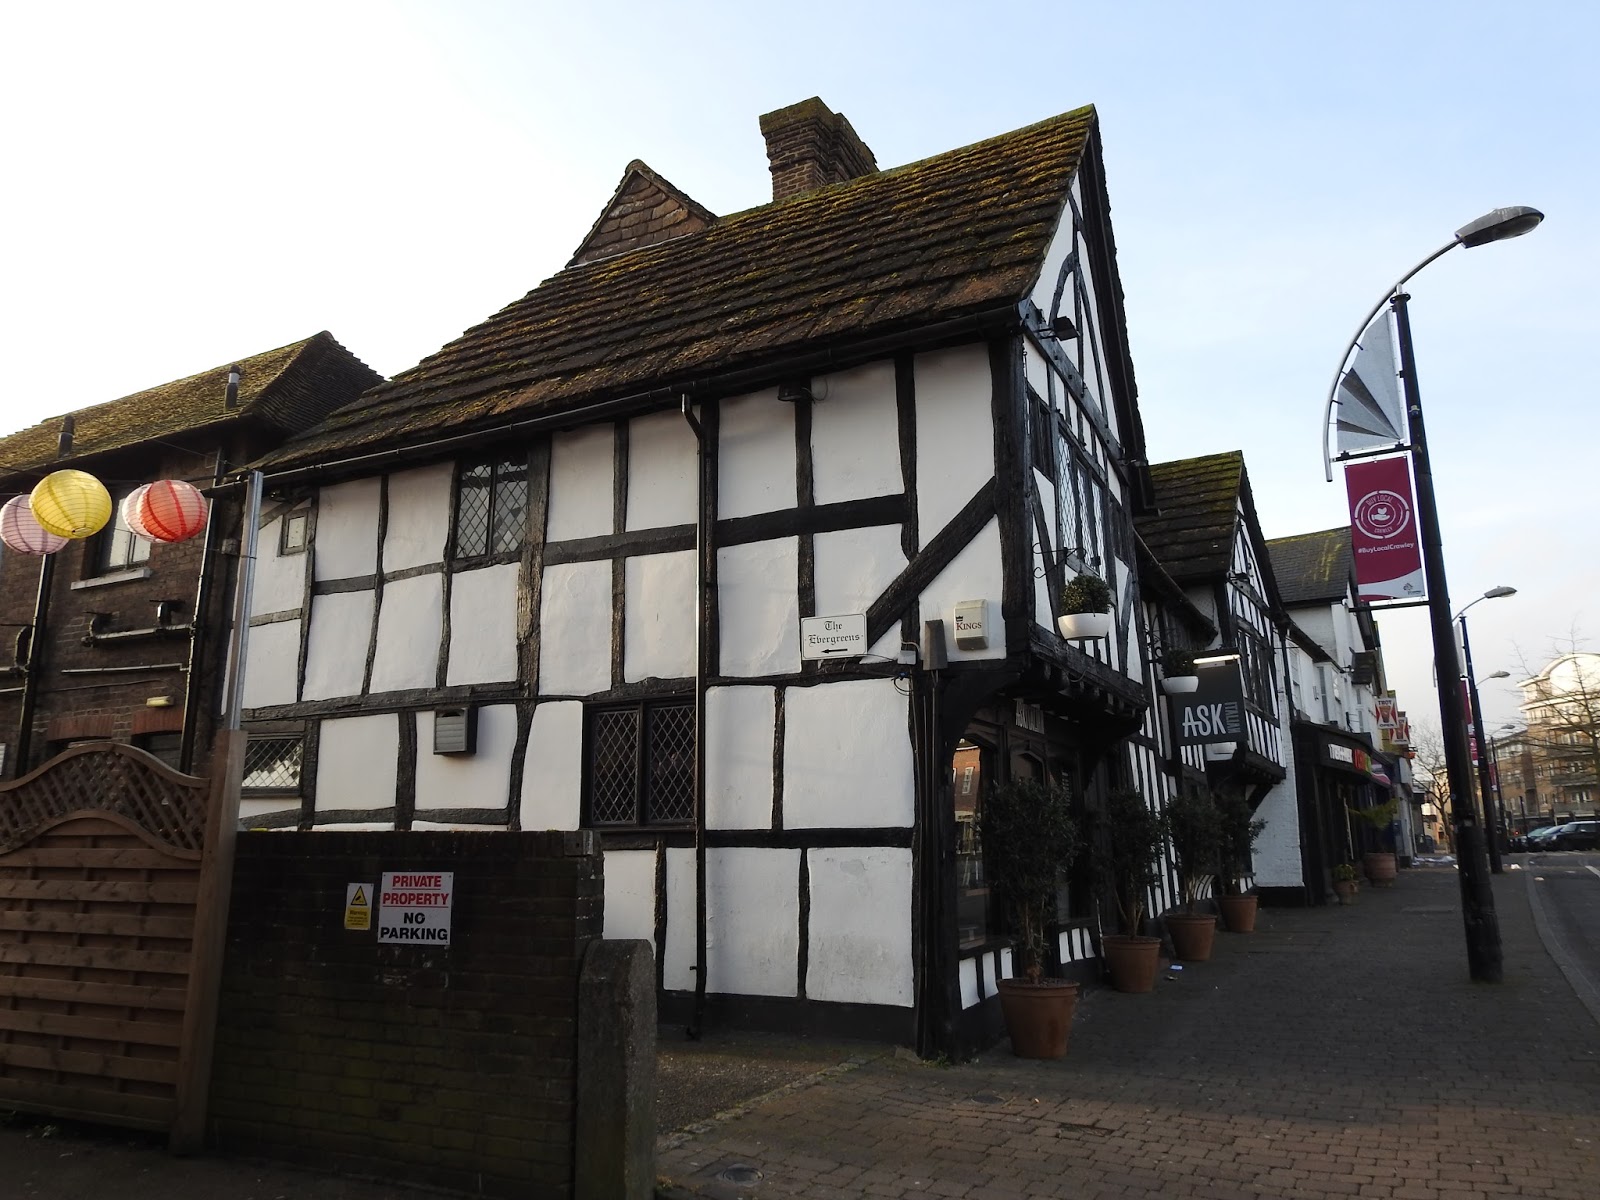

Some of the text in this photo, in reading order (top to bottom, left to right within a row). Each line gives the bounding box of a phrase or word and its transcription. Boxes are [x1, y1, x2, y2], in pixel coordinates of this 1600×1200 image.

[1358, 542, 1415, 554] #BuyLocalCrawley
[824, 620, 843, 632] The
[956, 621, 982, 631] KINGS
[808, 634, 860, 647] Evergreens
[1182, 703, 1227, 738] ASK
[392, 875, 442, 888] PRIVATE
[382, 893, 449, 905] PROPERTY
[403, 912, 426, 924] NO
[380, 927, 448, 941] PARKING
